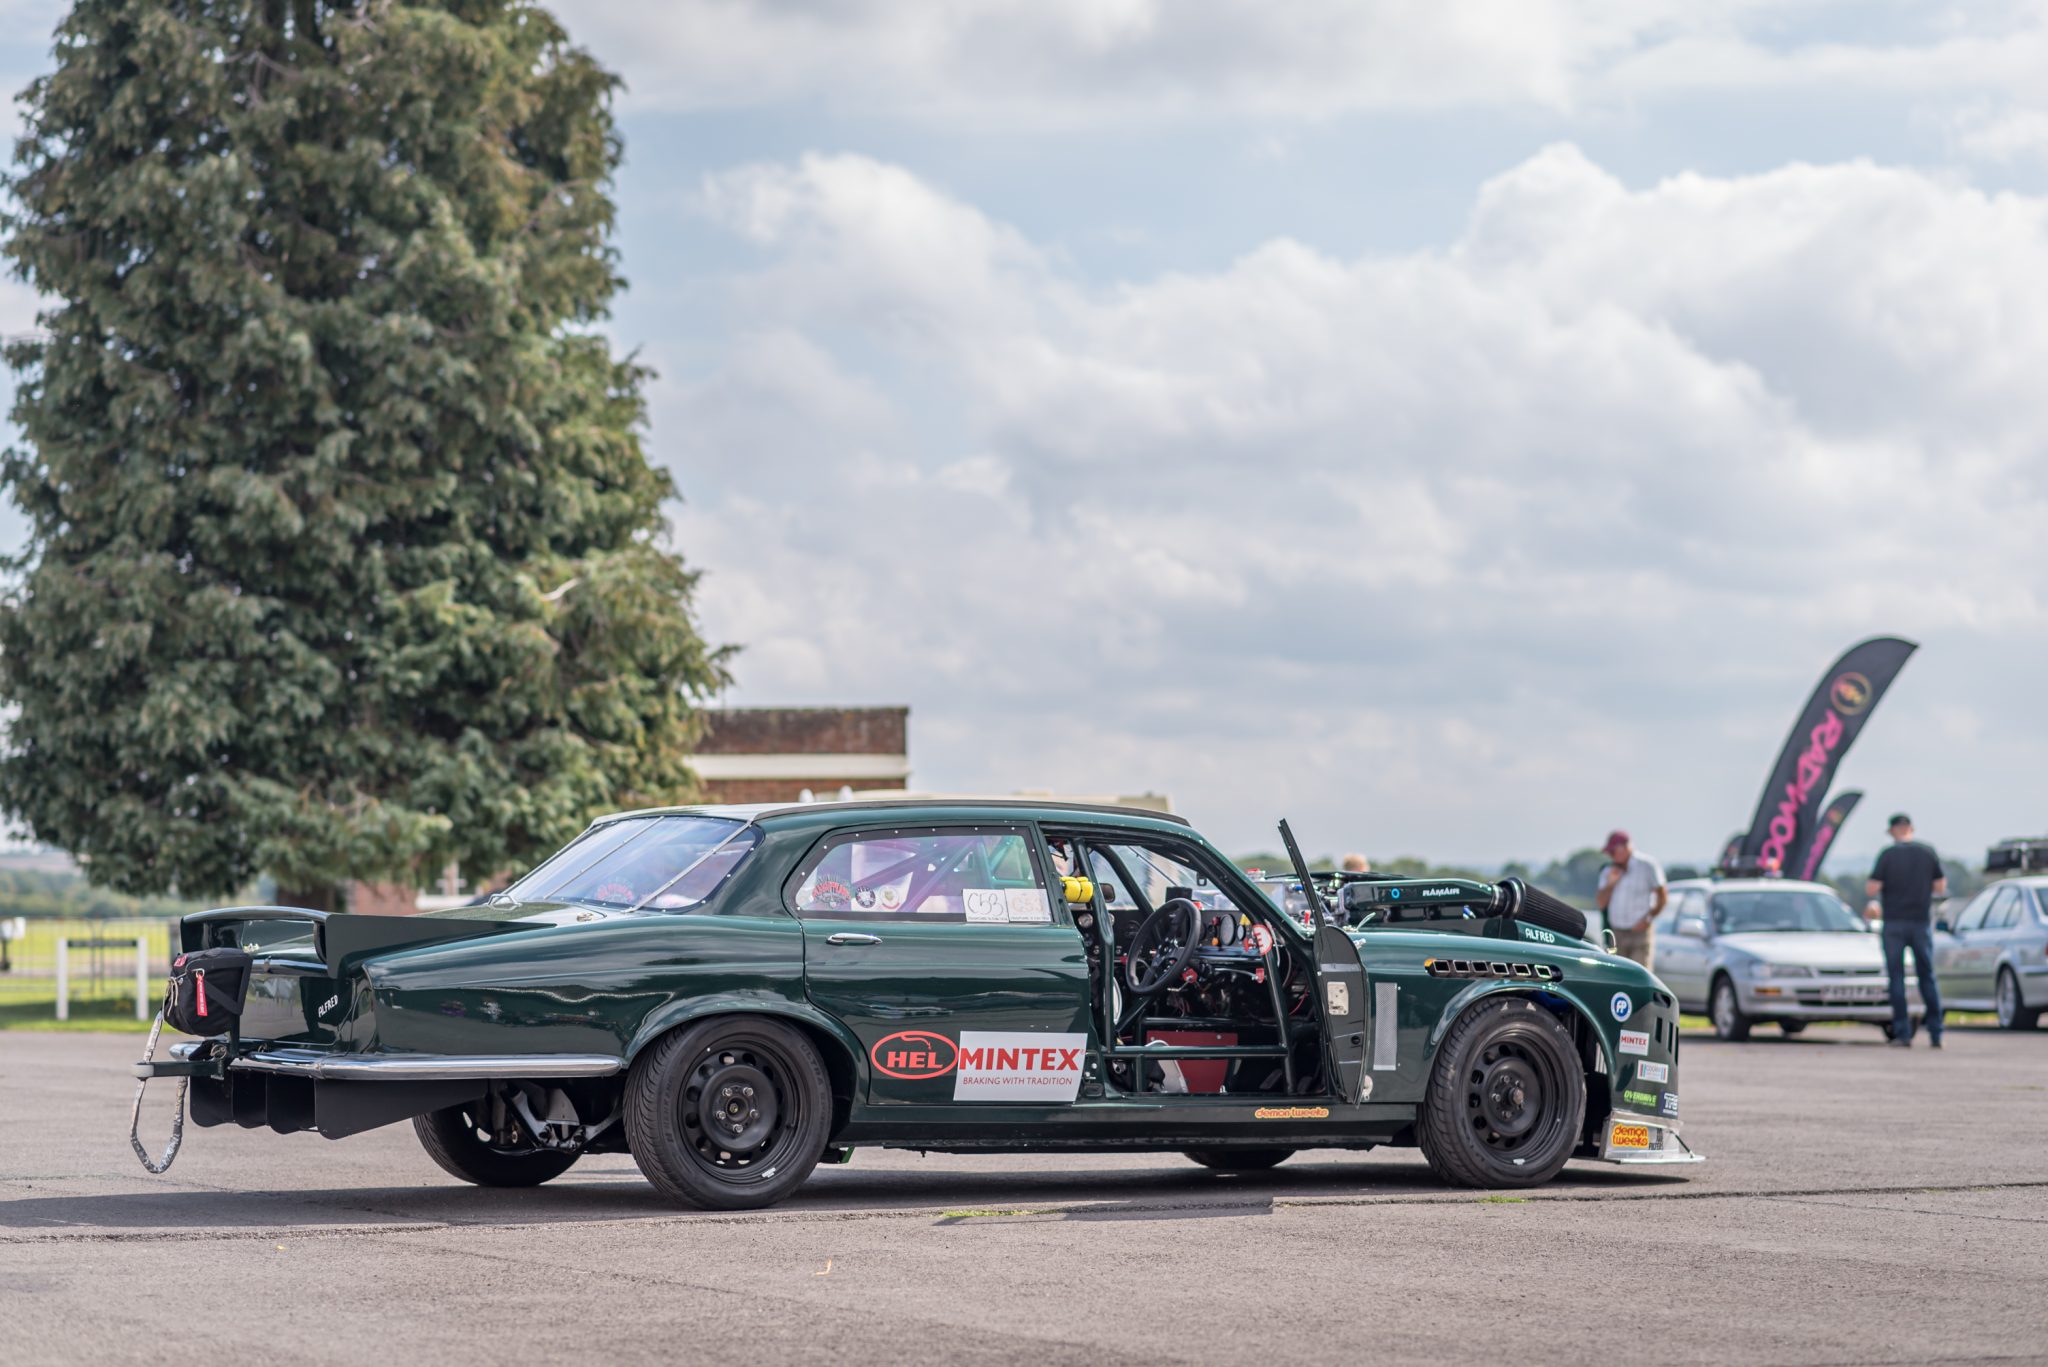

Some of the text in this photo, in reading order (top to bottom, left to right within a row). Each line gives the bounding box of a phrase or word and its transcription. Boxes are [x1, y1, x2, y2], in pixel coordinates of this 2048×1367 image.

[1422, 887, 1460, 897] RAMAIR
[1525, 928, 1556, 944] ALFRED
[317, 995, 339, 1018] ALFRED
[1621, 1036, 1647, 1046] MINTEX
[886, 1051, 943, 1068] HEL
[959, 1047, 1081, 1071] MINTEX
[963, 1077, 1073, 1085] BRAKING WITH TRADITION
[1256, 1107, 1328, 1118] demon tweeks
[1614, 1124, 1648, 1137] demon
[1612, 1134, 1649, 1147] tweeks
